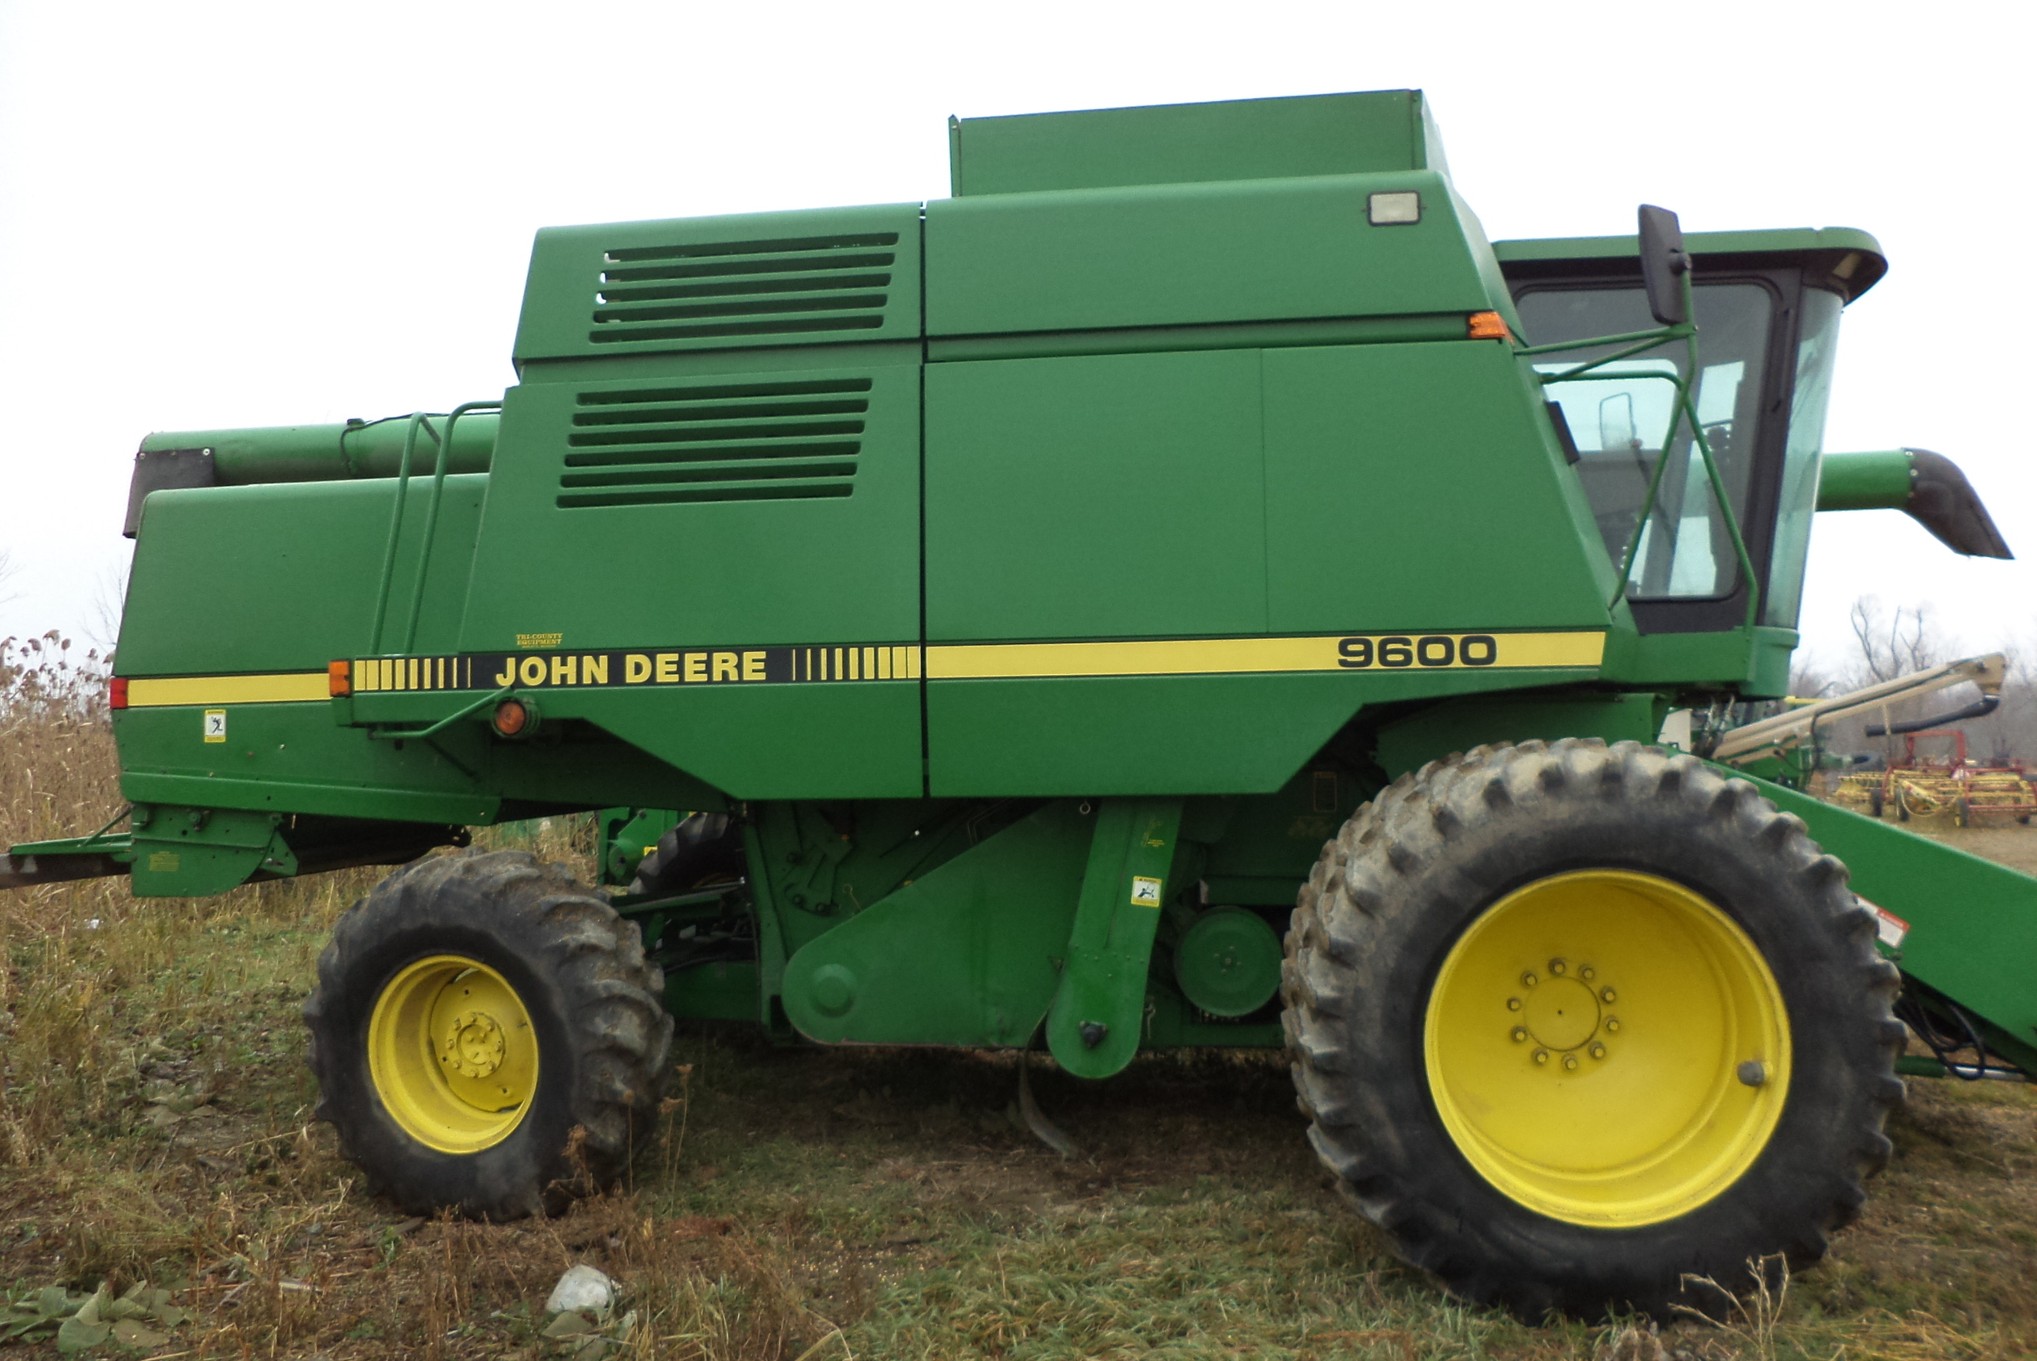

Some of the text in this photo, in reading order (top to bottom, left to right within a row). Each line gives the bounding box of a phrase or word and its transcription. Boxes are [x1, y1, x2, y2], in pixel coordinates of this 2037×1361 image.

[1337, 635, 1497, 668] 9600
[496, 651, 767, 687] JOHN DEERE
